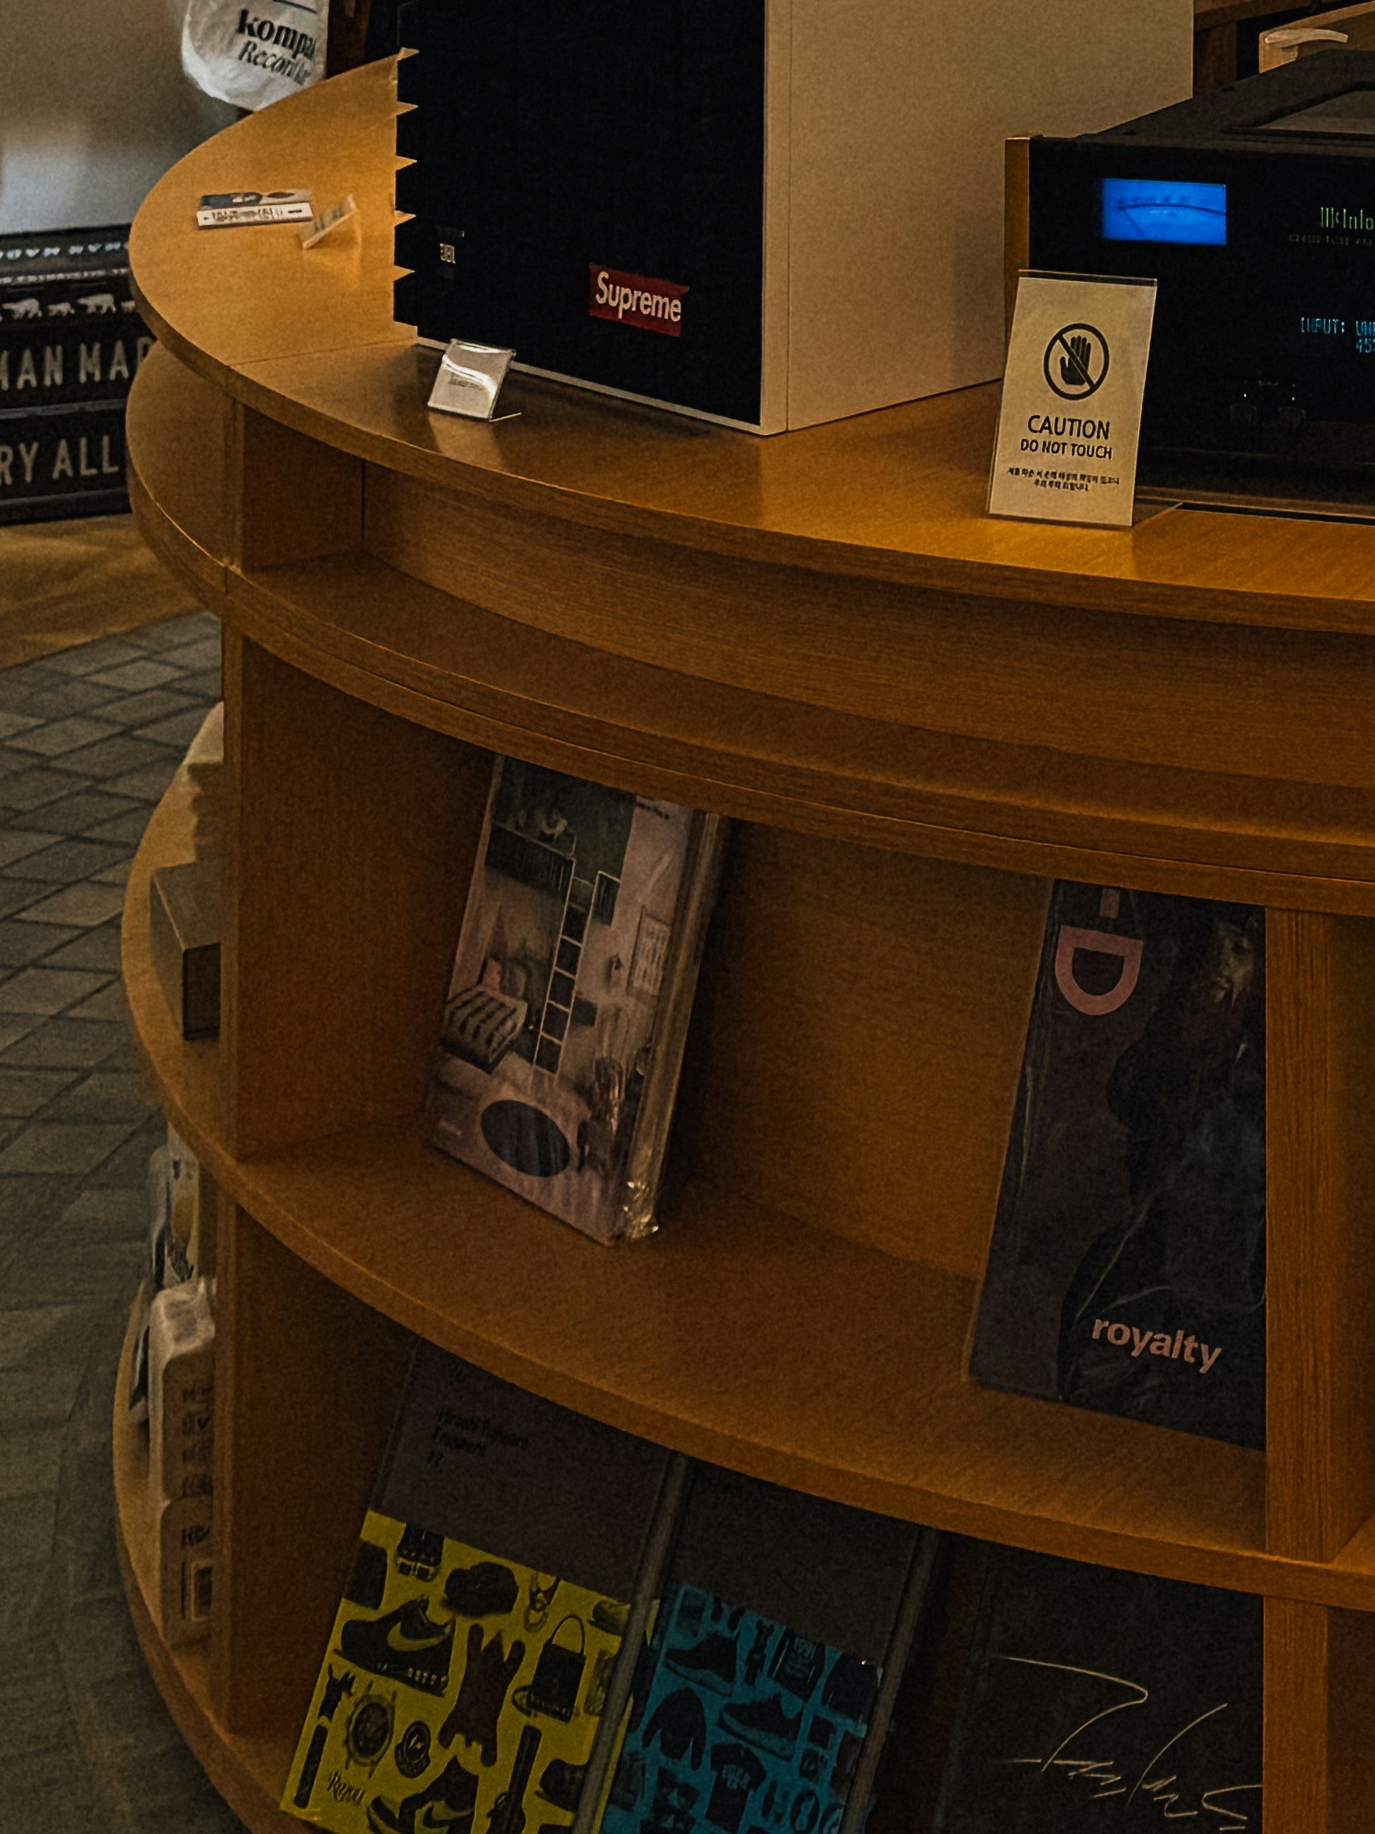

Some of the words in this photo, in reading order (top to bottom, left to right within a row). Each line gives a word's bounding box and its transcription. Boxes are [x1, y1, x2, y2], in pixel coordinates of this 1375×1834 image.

[595, 270, 682, 323] Supreme
[1020, 438, 1039, 452] DO
[1041, 440, 1067, 455] NOT
[1071, 443, 1113, 460] TOUCH
[1027, 414, 1111, 440] CAUTION
[52, 433, 120, 482] ALL
[1091, 1315, 1222, 1375] royalty
